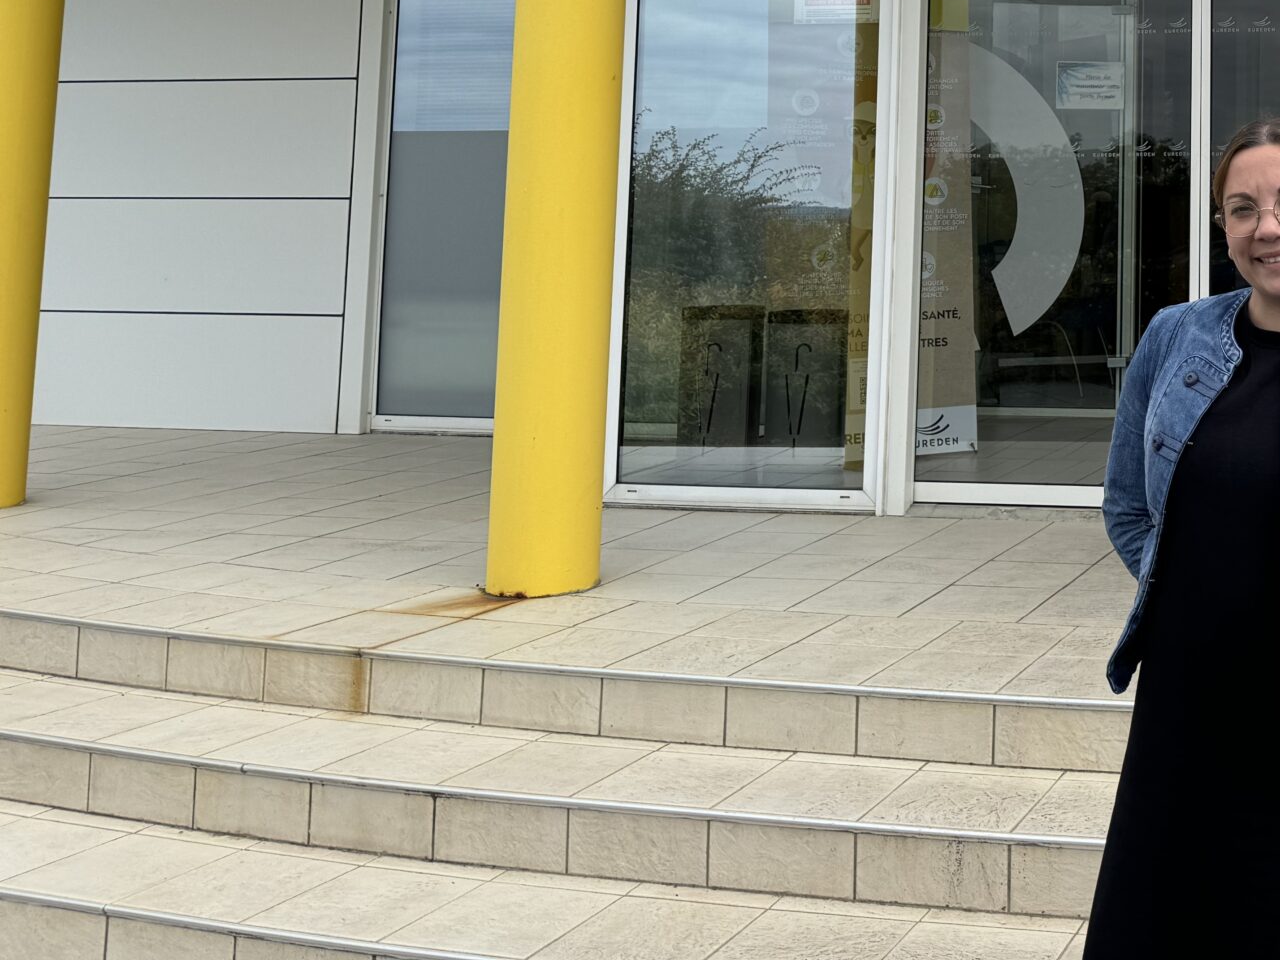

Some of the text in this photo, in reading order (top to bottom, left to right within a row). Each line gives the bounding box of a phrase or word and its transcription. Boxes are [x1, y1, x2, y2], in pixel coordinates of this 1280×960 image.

[921, 306, 961, 321] SANTÉ,
[920, 337, 948, 348] TRES
[916, 436, 959, 448] UREDEN
